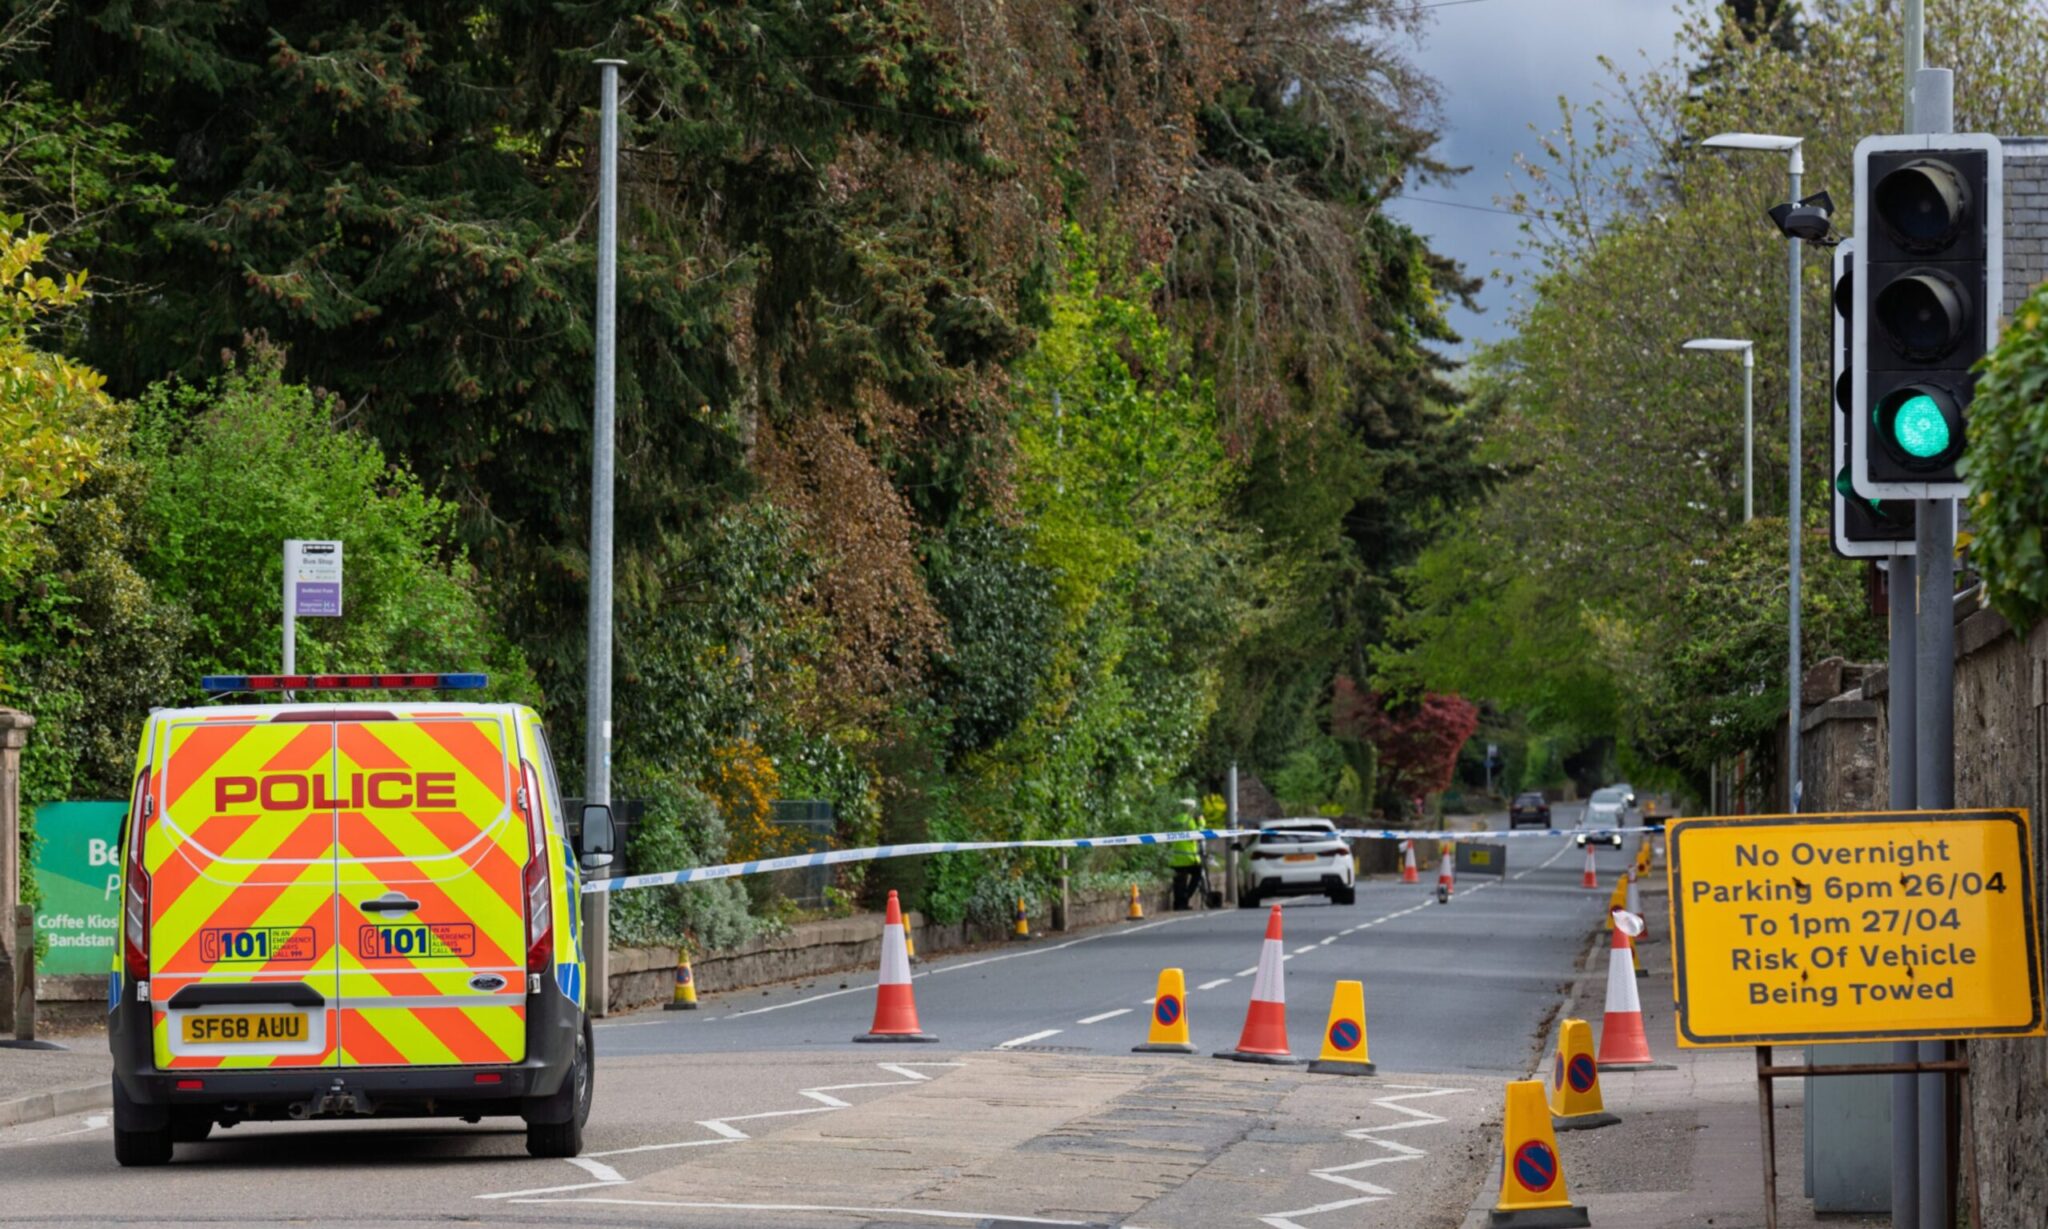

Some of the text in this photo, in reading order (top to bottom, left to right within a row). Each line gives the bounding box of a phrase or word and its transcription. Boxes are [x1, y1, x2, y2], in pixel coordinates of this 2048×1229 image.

[215, 772, 456, 812] POLICE
[1736, 839, 1950, 867] No Overnight
[1692, 872, 2006, 904] Parking 6pm 26/04
[38, 914, 84, 928] Coffee
[1740, 908, 1961, 938] To 1pm 27/04
[48, 933, 115, 947] Bandstan
[221, 931, 267, 958] 101
[381, 928, 426, 954] 101
[1732, 943, 1977, 971] Risk Of Vehicle
[1749, 977, 1954, 1007] Being Towed
[191, 1016, 299, 1039] SF68 AUU
